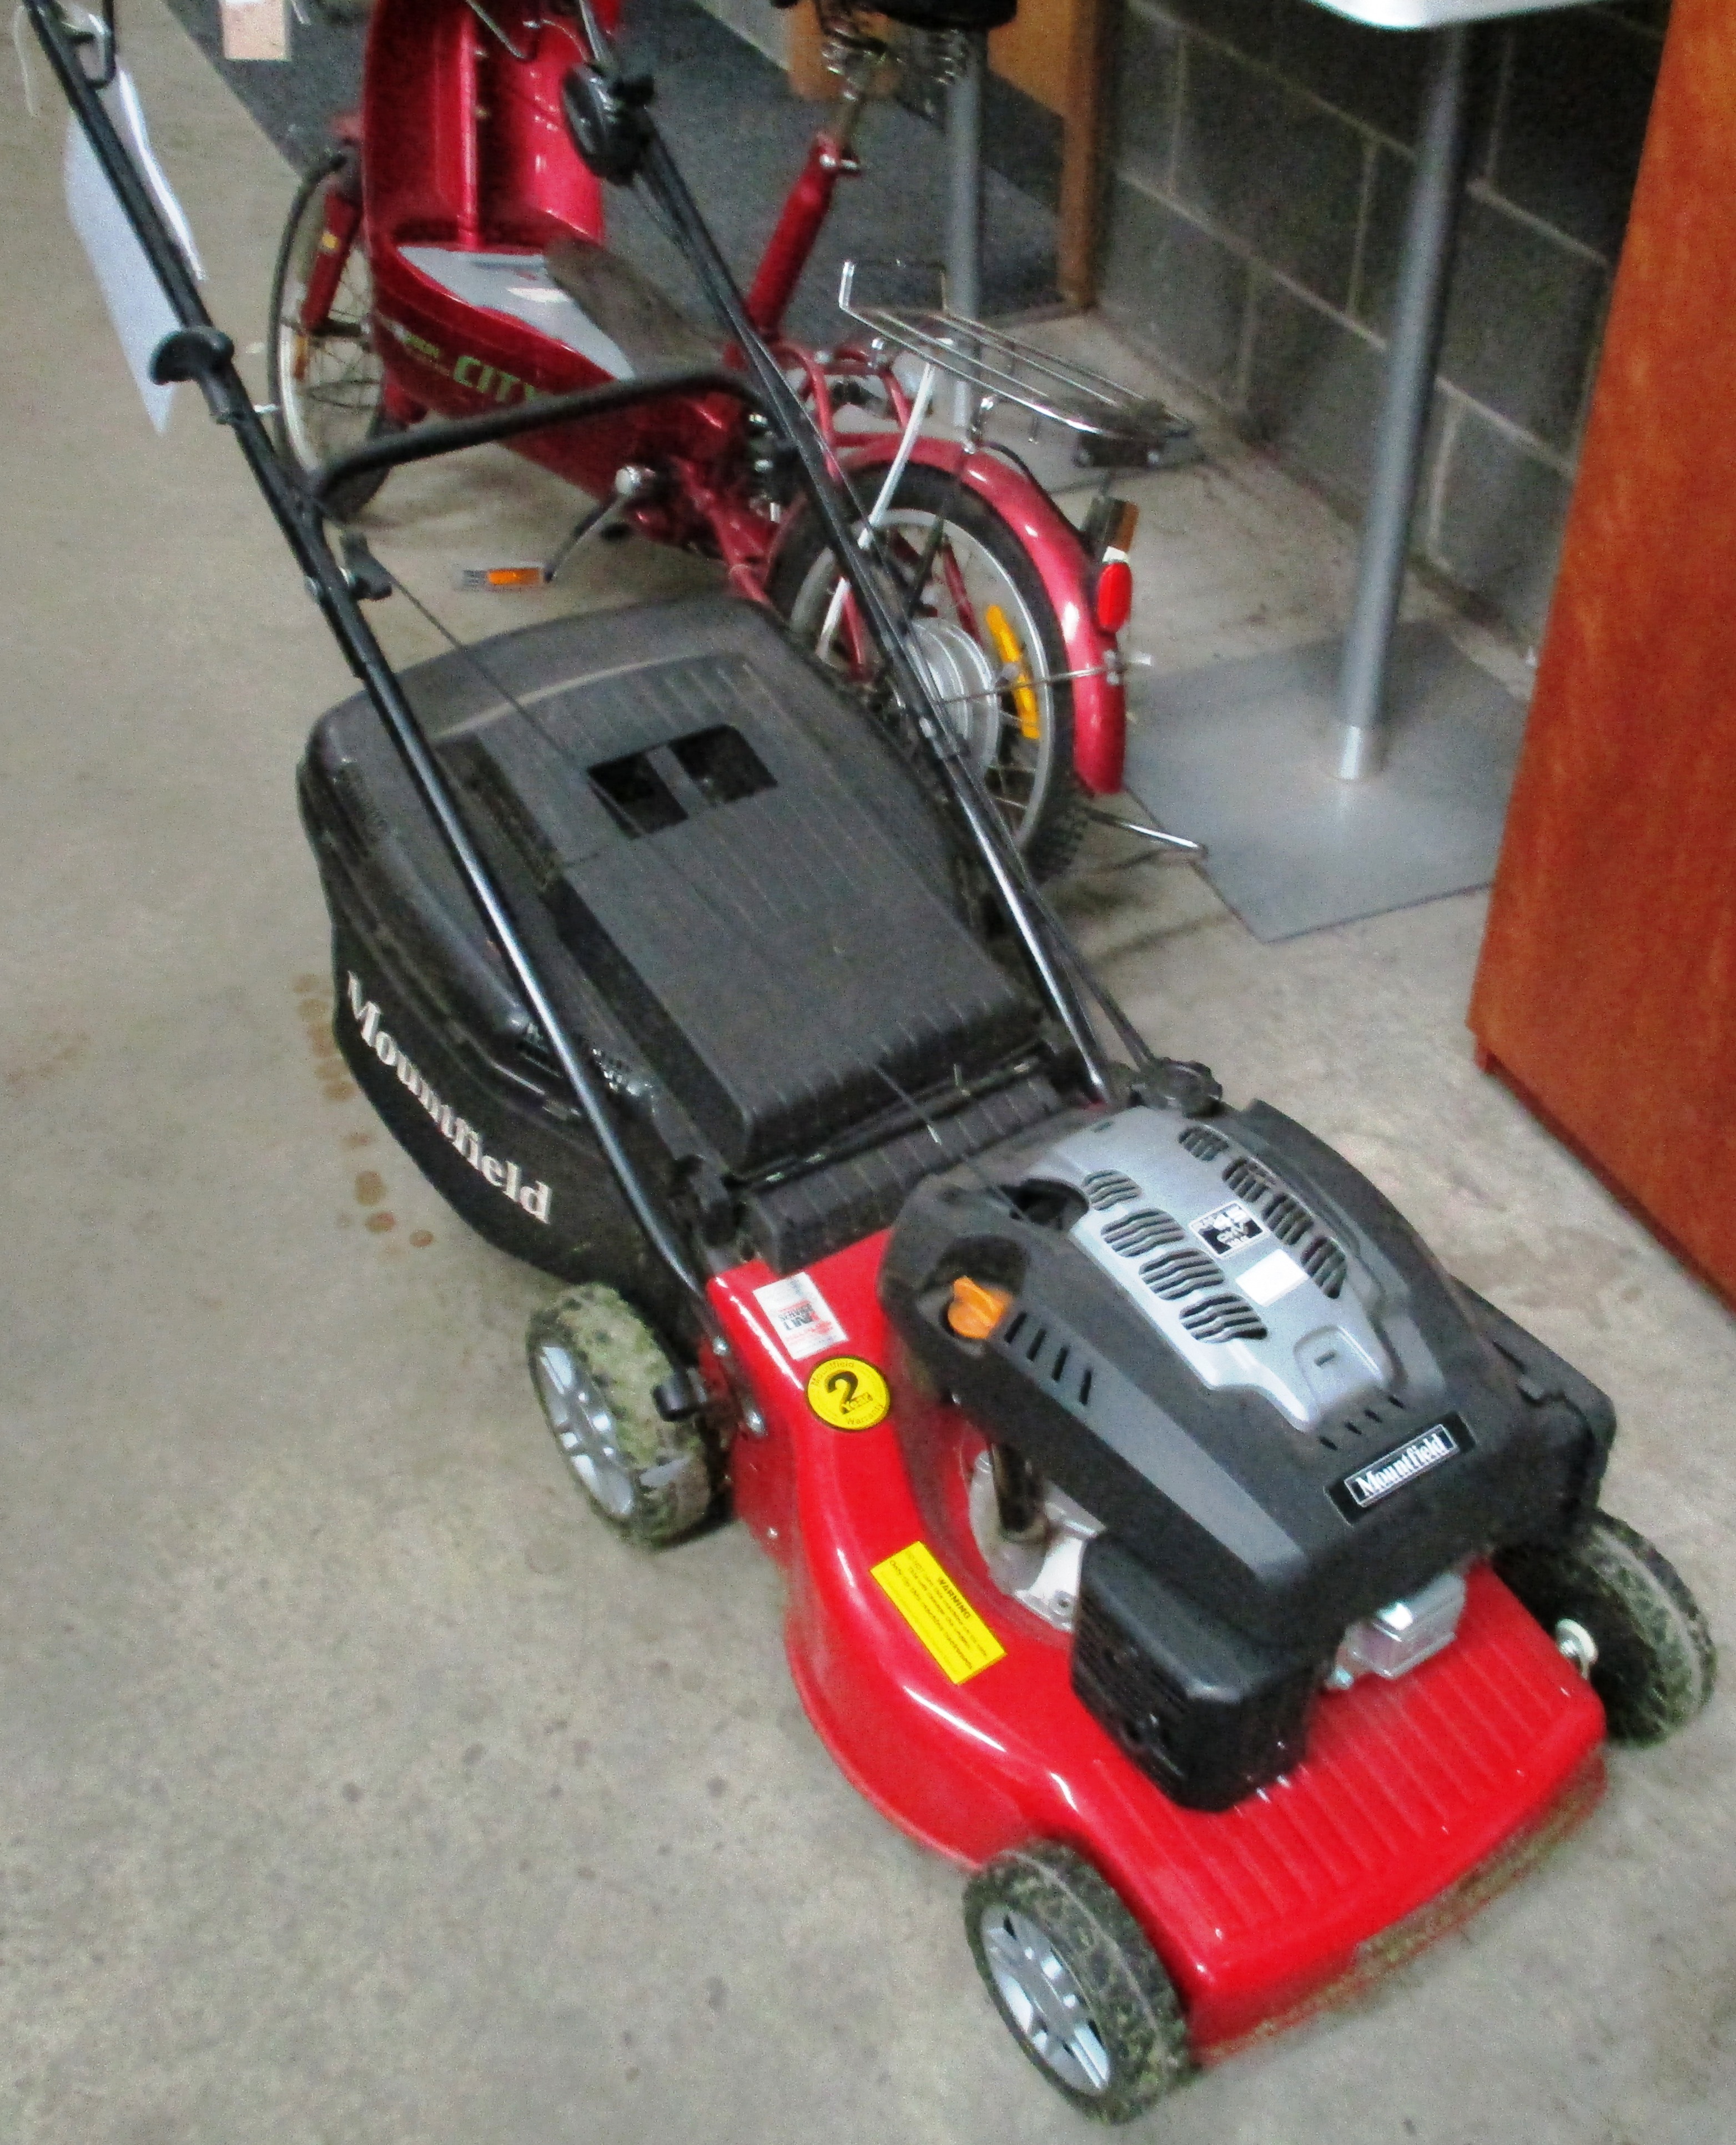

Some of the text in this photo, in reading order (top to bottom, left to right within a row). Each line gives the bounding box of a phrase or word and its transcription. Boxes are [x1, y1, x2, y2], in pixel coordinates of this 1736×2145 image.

[348, 970, 551, 1225] Mountfield
[811, 1362, 854, 1387] Mountfield
[825, 1369, 872, 1414] 2
[847, 1403, 885, 1425] Warranty
[1355, 1433, 1450, 1497] Mountfield
[937, 1577, 972, 1619] WARNING
